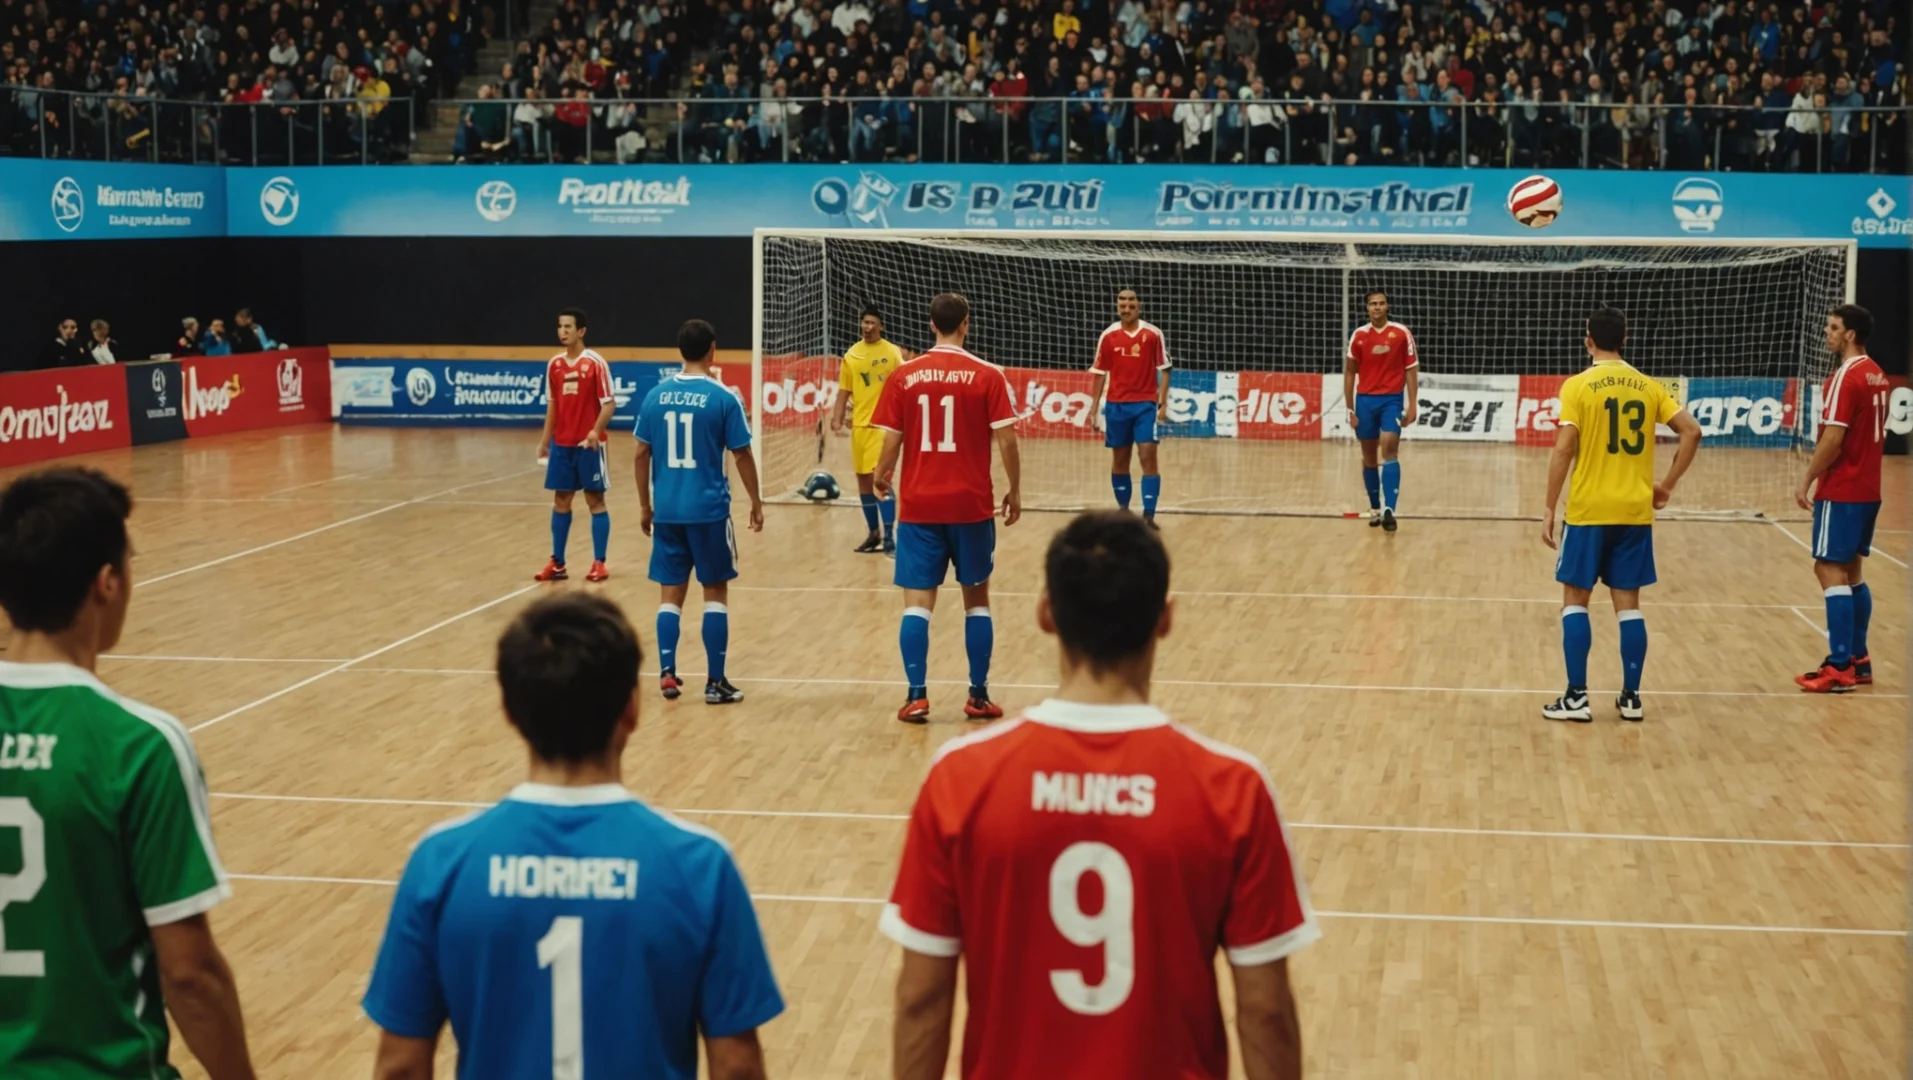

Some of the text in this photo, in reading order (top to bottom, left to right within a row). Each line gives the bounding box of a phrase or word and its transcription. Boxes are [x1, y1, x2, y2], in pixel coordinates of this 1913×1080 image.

[918, 394, 957, 453] 11
[1604, 397, 1646, 455] 13
[1049, 840, 1135, 1016] 9
[536, 916, 584, 1080] 1
